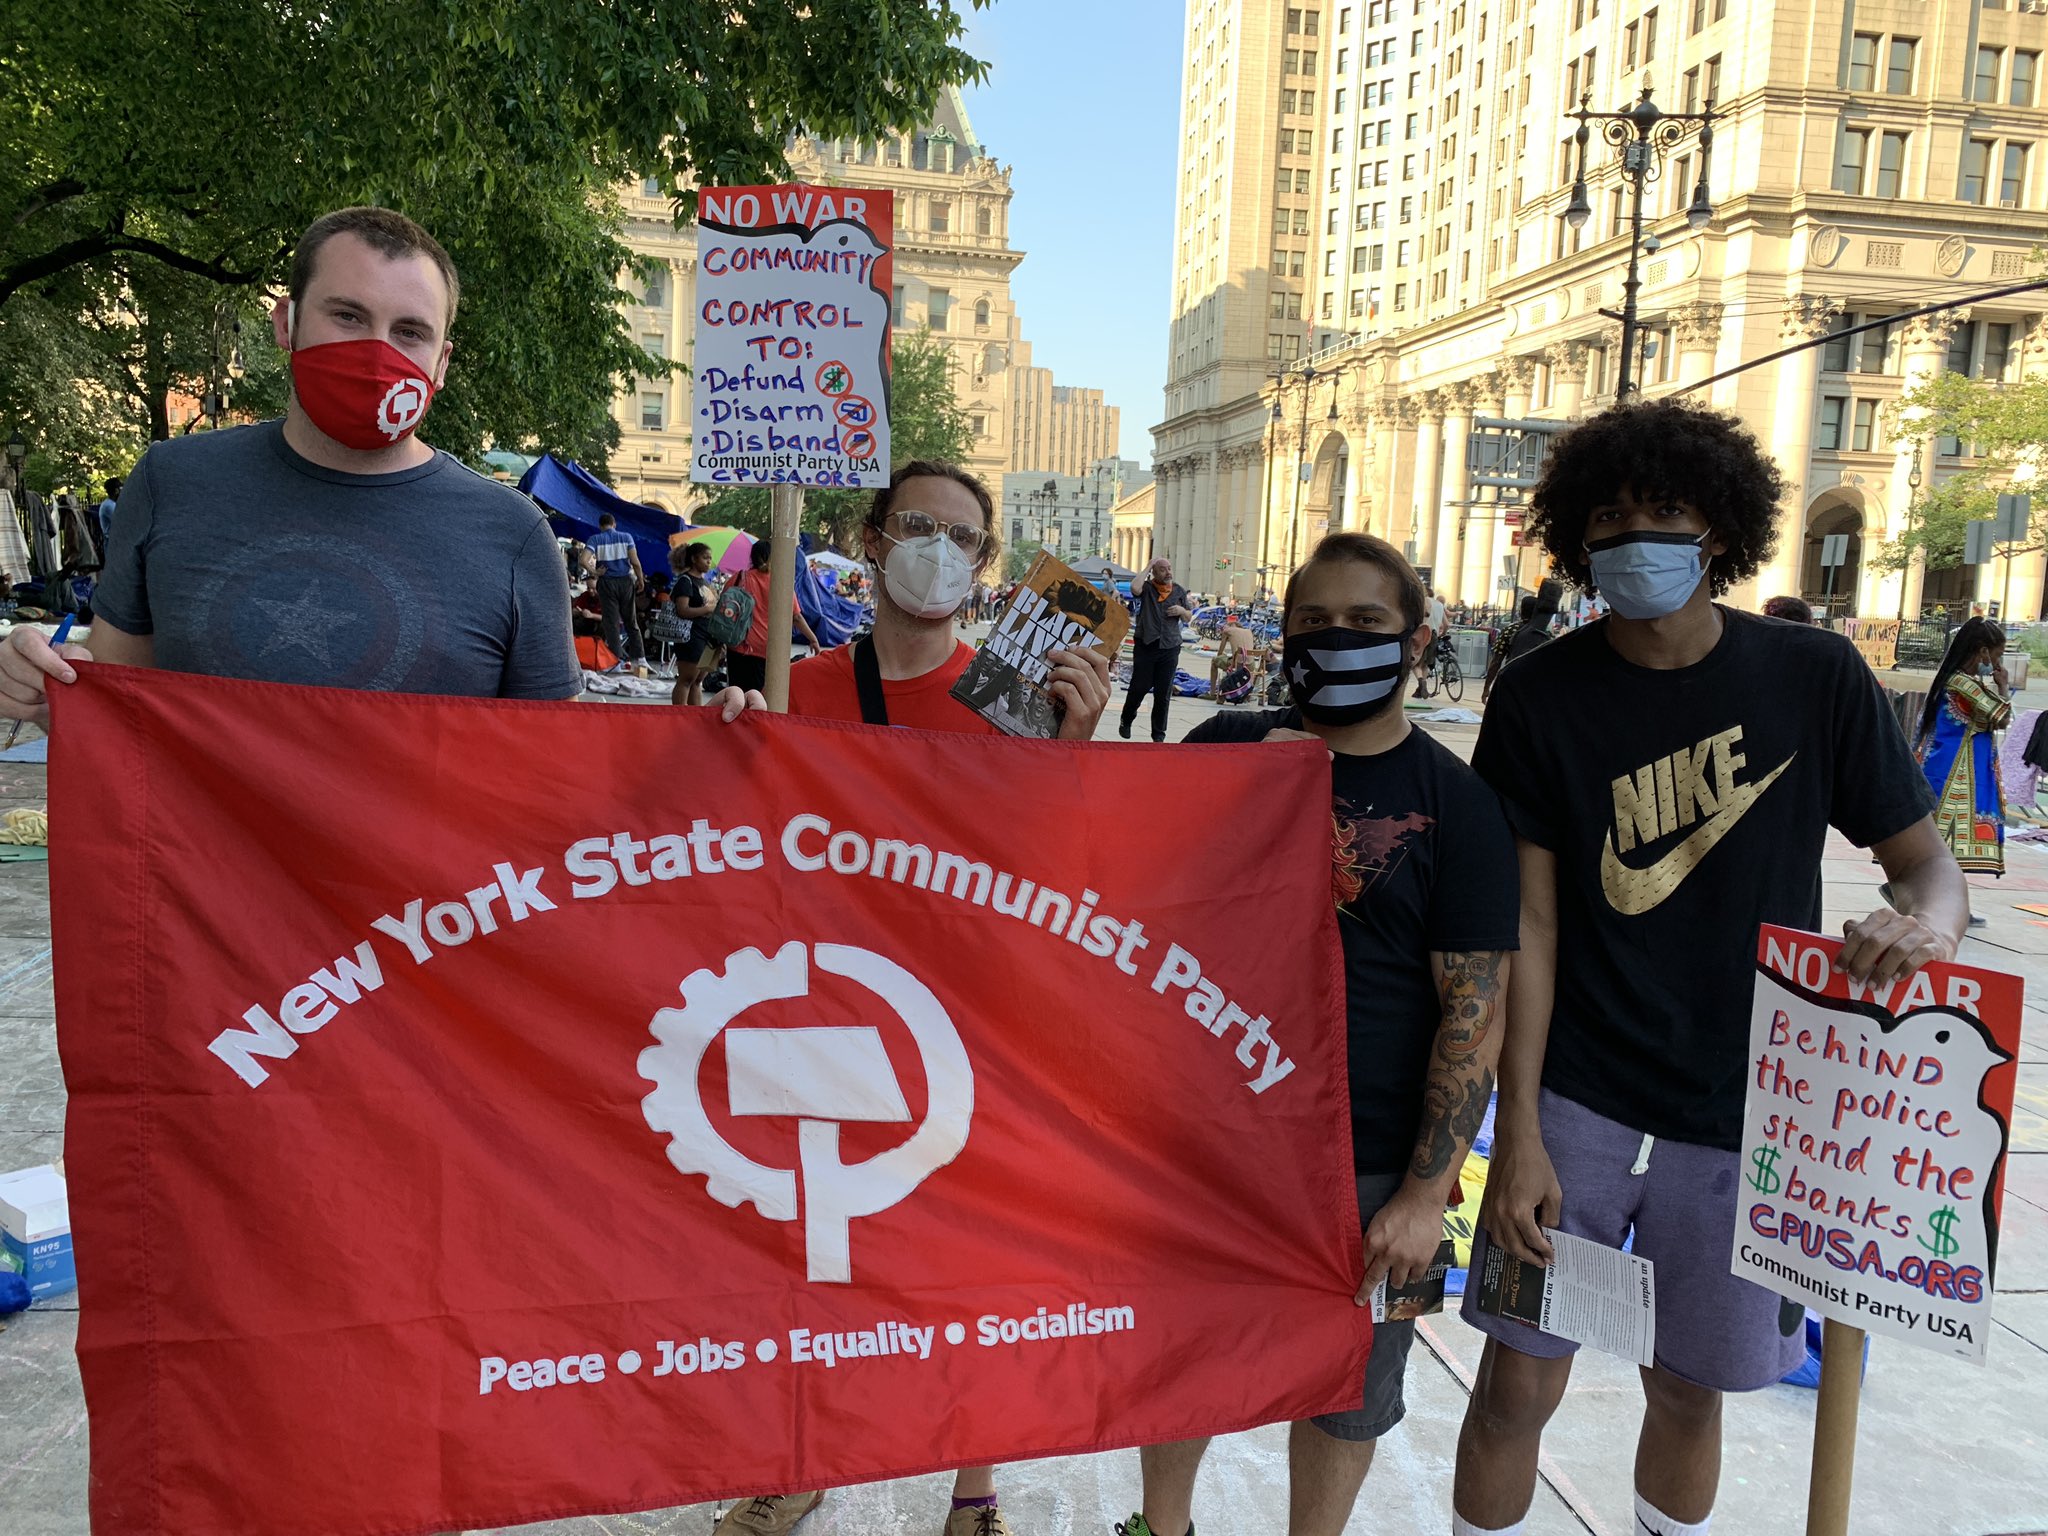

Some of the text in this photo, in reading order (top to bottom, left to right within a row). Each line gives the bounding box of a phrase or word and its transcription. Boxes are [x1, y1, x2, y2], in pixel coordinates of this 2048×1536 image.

[704, 191, 867, 231] NO WAR
[703, 246, 873, 284] COMMUNITY
[702, 298, 864, 329] CONTROL
[746, 335, 814, 361] TO:
[706, 364, 805, 393] Defund
[712, 399, 824, 424] Disarm
[710, 424, 841, 456] Disband
[697, 453, 880, 474] Communist Party USA
[712, 468, 861, 487] CPUSA.ORG
[1012, 586, 1104, 648] BLACK
[998, 607, 1068, 668] LIV
[985, 633, 1053, 690] MATT
[1611, 725, 1750, 853] NIKE
[207, 813, 1296, 1094] New York State Communist Party
[1765, 936, 1830, 994] NO
[1756, 1054, 1960, 1137] the police
[1763, 1114, 1975, 1200] stand the
[33, 1242, 60, 1255] KN95
[1749, 1203, 1984, 1304] CPUSA.ORG
[1510, 1283, 1520, 1309] Tyner
[1546, 1282, 1553, 1296] no
[1640, 1263, 1651, 1309] an update
[1740, 1244, 1974, 1344] Communist Party USA
[1376, 1307, 1382, 1317] no
[1542, 1297, 1552, 1331] peace!
[479, 1302, 1134, 1395] Peace Jobs Equality Socialism
